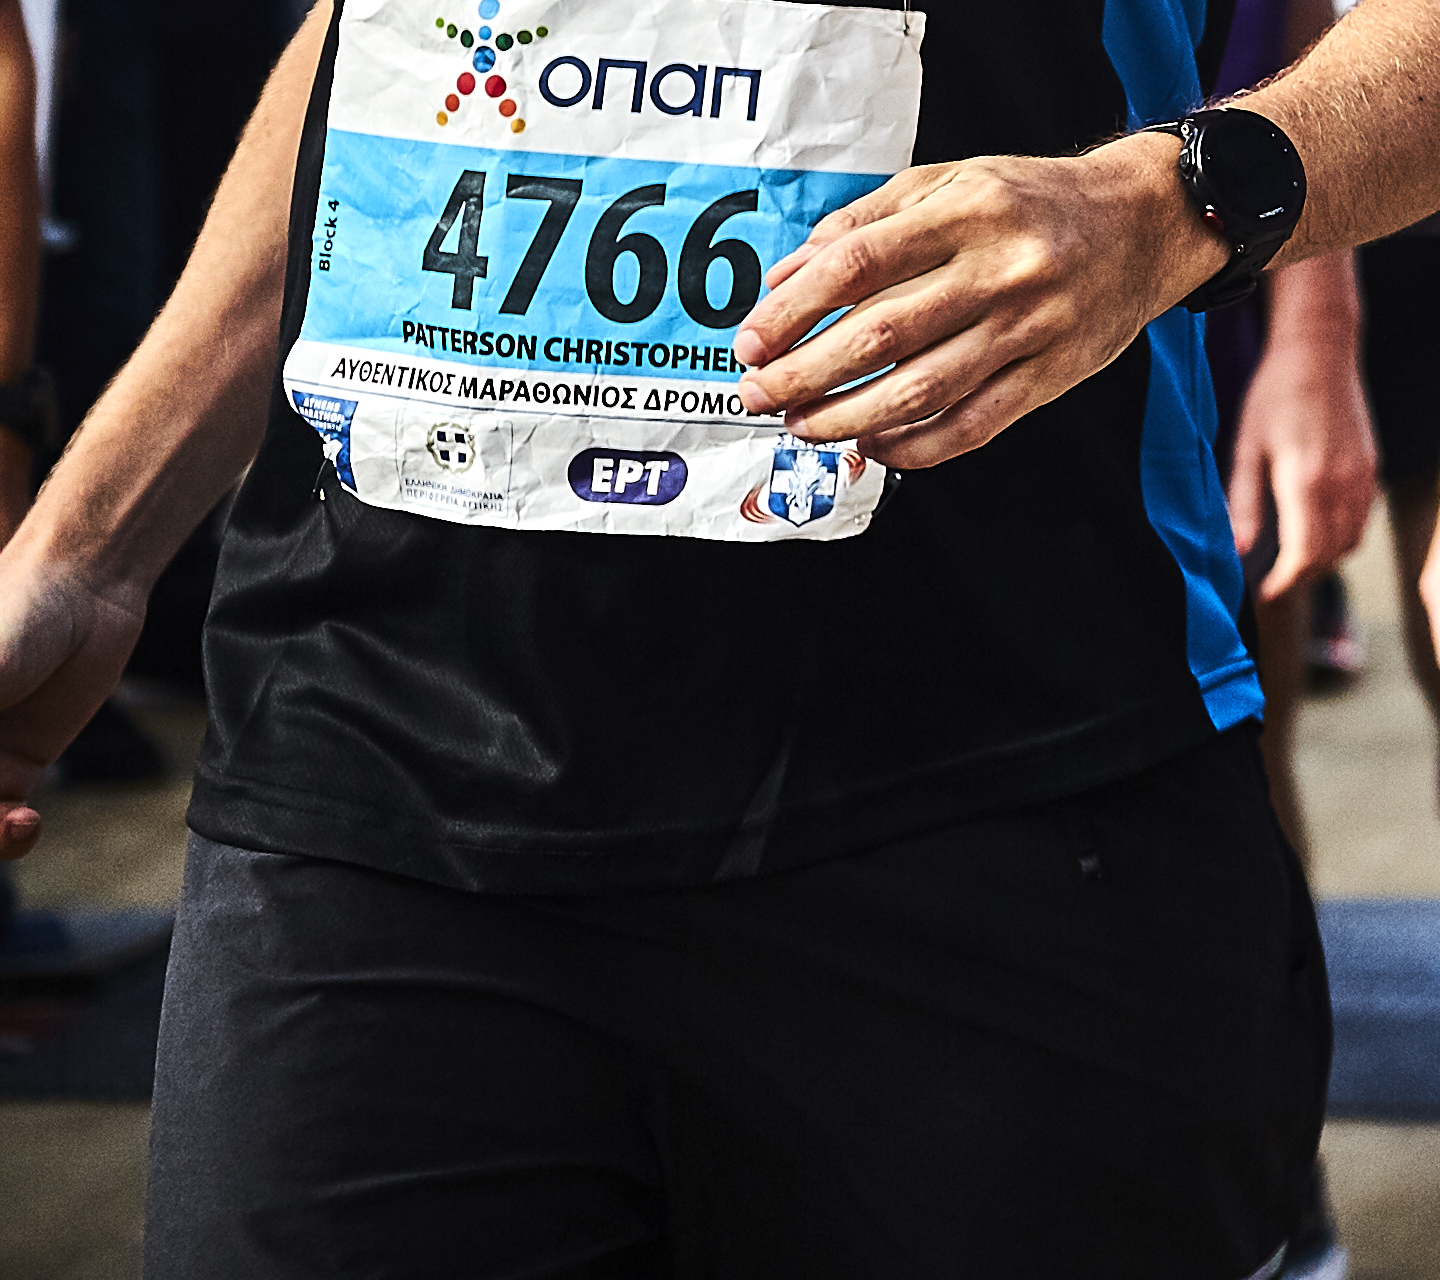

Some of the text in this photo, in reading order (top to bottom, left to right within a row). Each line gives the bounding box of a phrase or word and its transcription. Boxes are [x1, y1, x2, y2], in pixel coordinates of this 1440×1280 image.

[319, 199, 340, 271] Block 4
[421, 169, 765, 331] 4766
[402, 320, 538, 362] PATTERSON
[331, 357, 762, 417] ΑΥΘΕΝΤΙΚΟΣ ΜΑΡΑΘΩΝΙΟΣ ΔΡΟΜΟ
